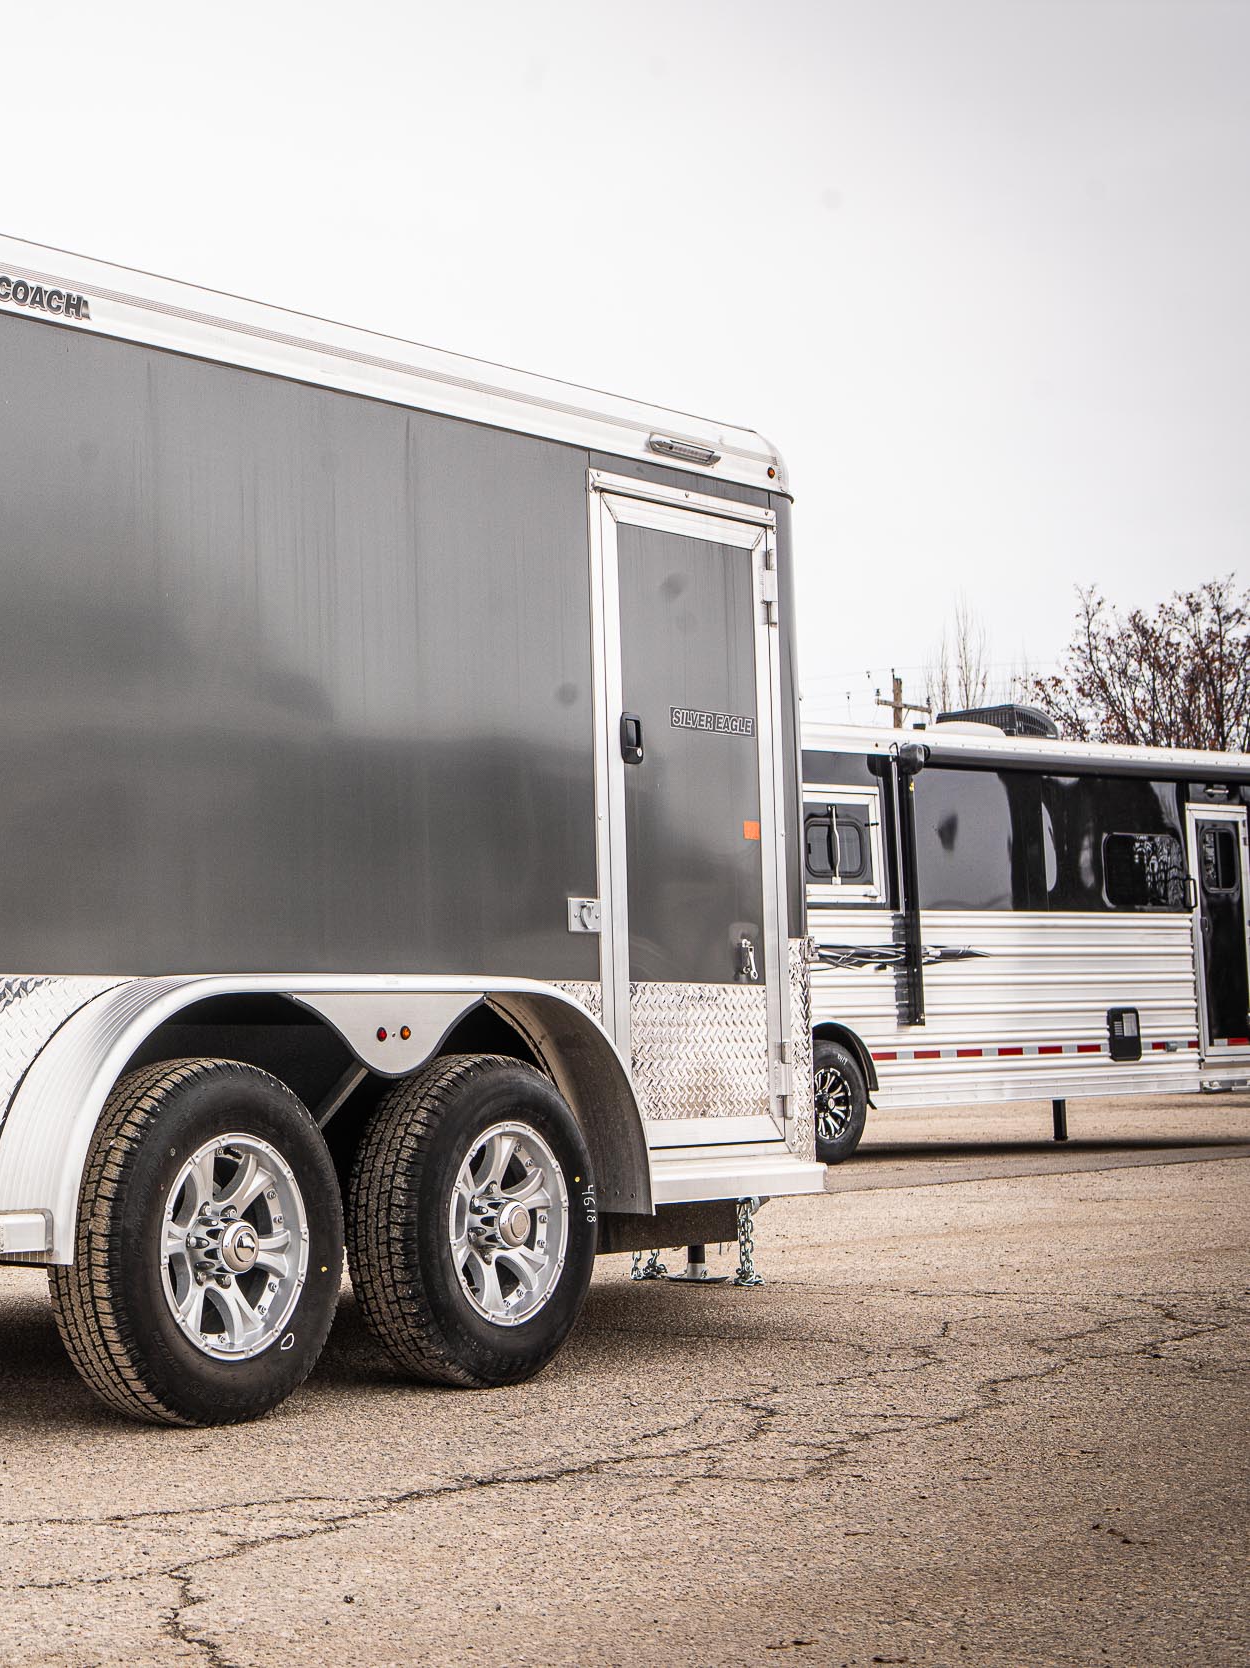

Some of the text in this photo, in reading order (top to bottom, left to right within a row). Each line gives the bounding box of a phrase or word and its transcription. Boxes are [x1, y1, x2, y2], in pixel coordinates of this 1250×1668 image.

[673, 708, 753, 735] SILVER EAGLE
[581, 1184, 597, 1223] 4618
